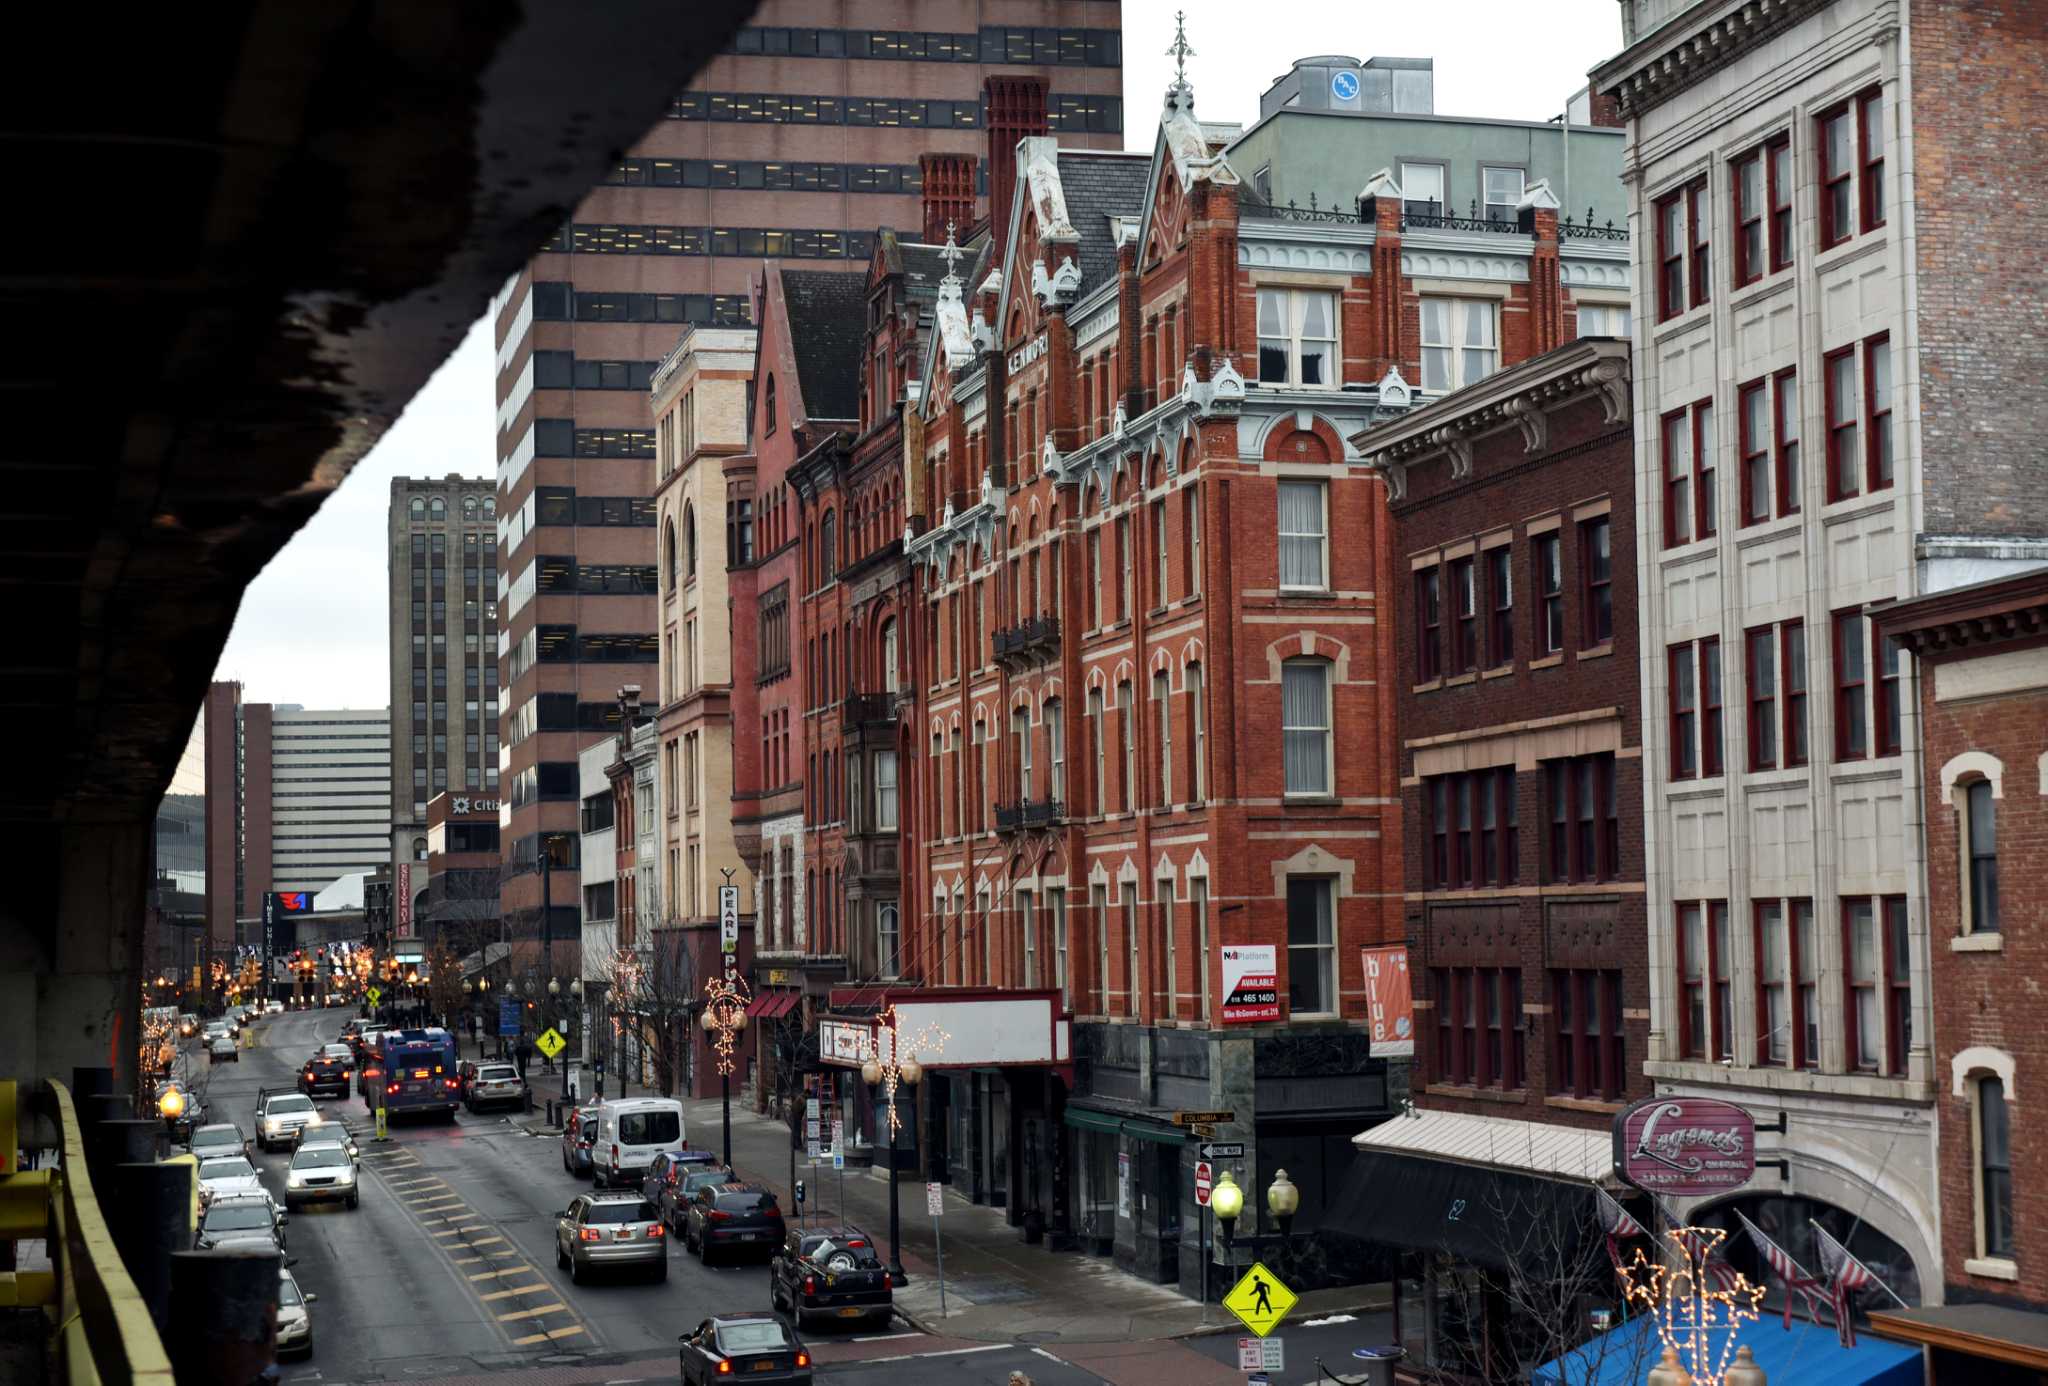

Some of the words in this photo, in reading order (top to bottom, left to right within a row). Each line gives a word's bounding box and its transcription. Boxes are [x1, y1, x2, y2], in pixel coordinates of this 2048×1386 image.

[1337, 75, 1356, 94] BAC
[724, 889, 735, 938] PEARL
[1241, 978, 1275, 988] AVAILABLE
[1243, 994, 1257, 1003] 465
[1258, 993, 1275, 1002] 1400
[1367, 953, 1385, 1041] blue
[1184, 1114, 1217, 1122] COLUMBIA
